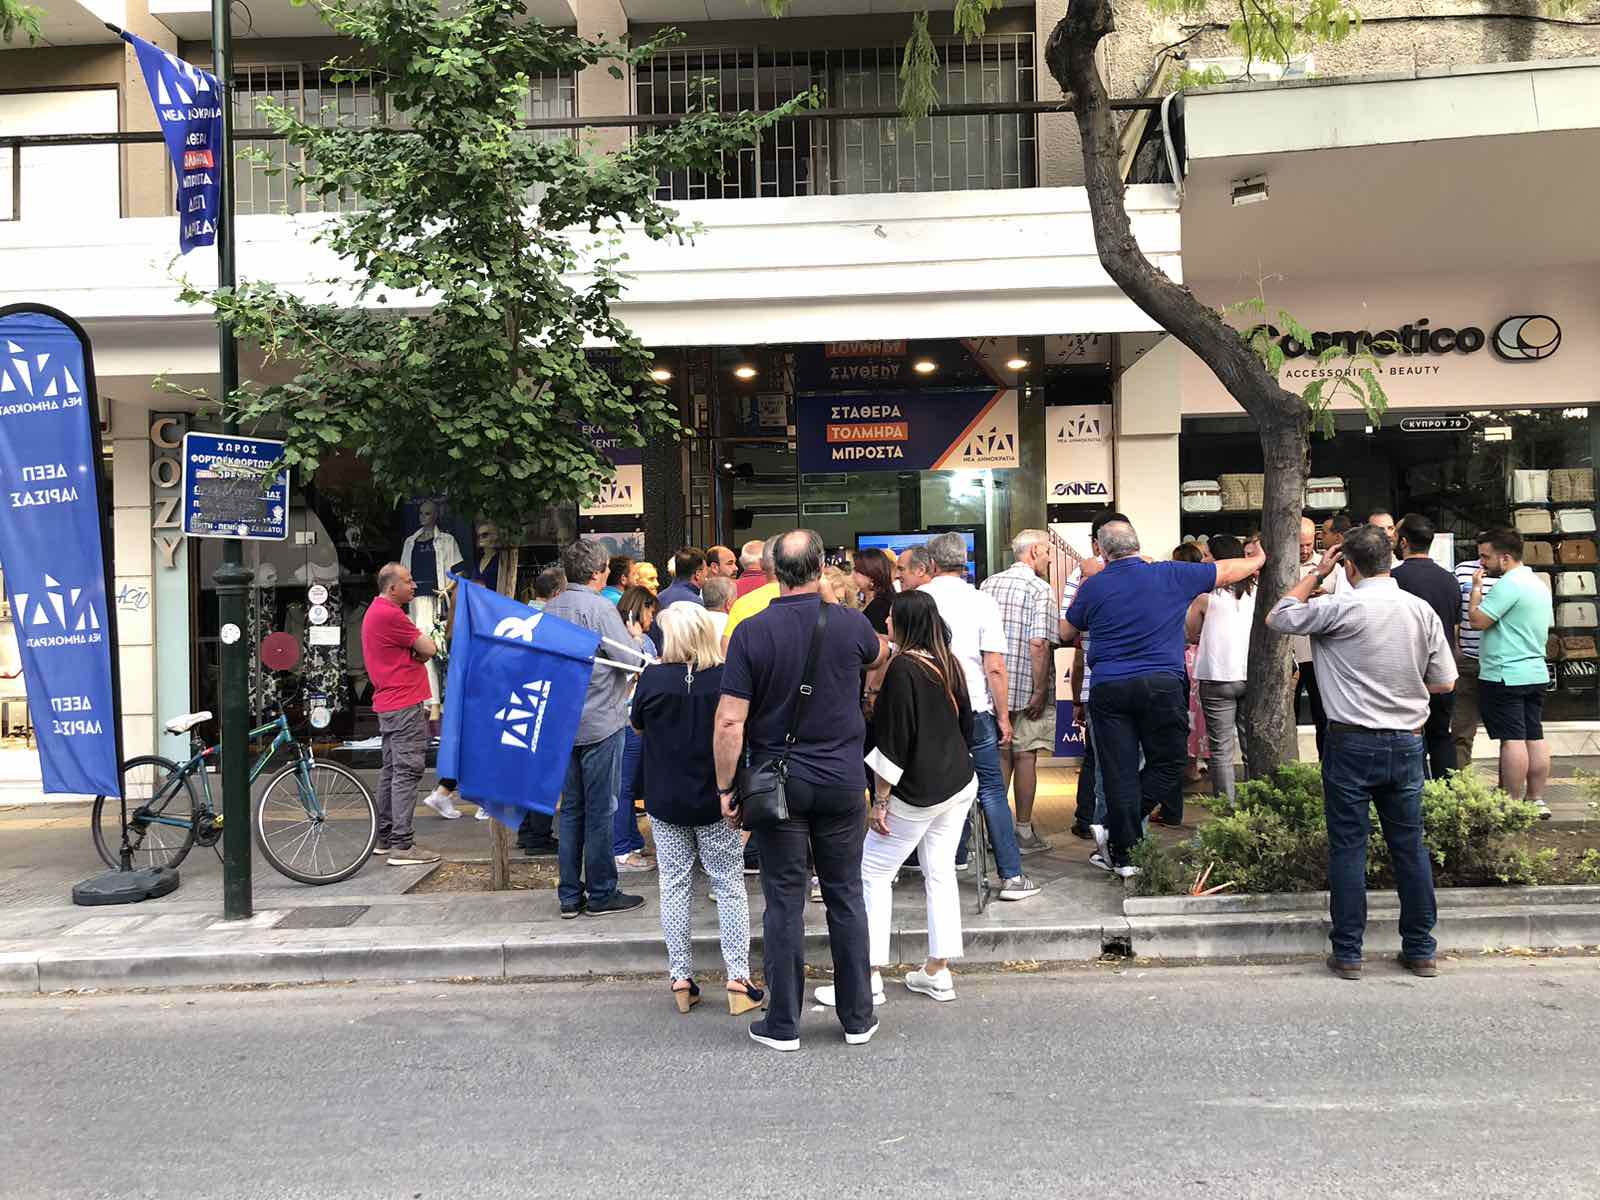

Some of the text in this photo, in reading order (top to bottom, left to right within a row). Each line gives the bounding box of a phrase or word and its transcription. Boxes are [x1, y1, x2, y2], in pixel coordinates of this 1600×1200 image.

[1286, 366, 1440, 379] ACCESSORI BEAUTY
[831, 405, 902, 420] ΣΤΑΘΕΡΑ
[1408, 421, 1447, 429] ΚΥΠΡΟΥ
[831, 426, 904, 440] ΤΟΛΜΗΡΑ
[217, 443, 257, 455] ΧΩΡΟΣ
[831, 446, 904, 460] ΜΠΡΟΣΤΑ
[151, 418, 183, 568] COZY
